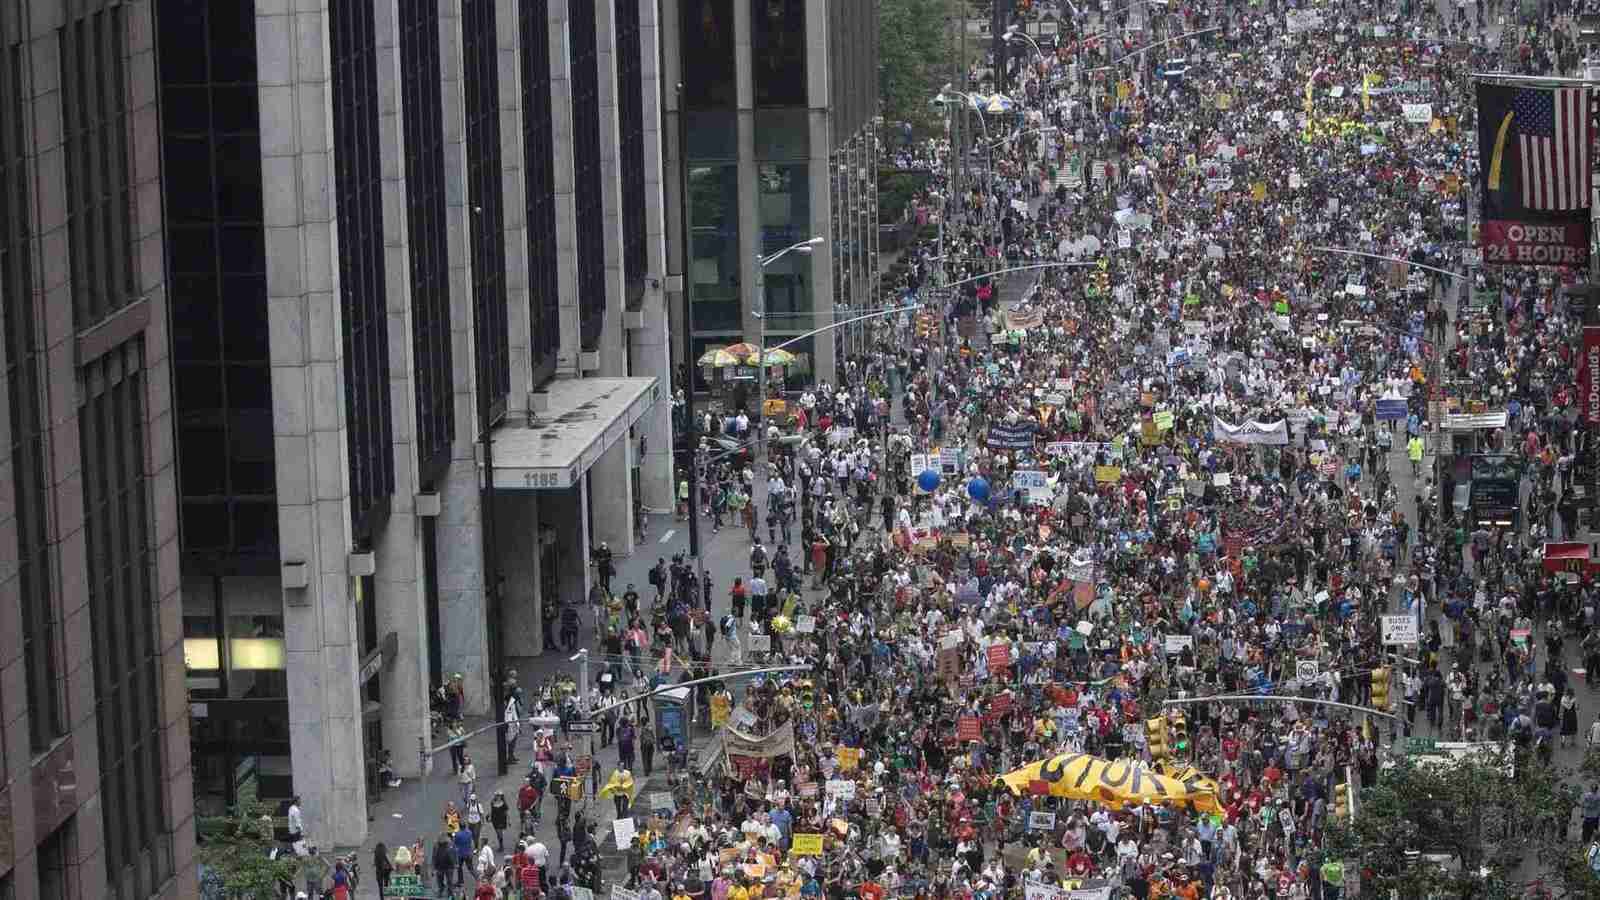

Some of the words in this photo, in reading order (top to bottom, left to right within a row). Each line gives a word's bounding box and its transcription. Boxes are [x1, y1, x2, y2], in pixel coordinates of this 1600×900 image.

[1508, 225, 1565, 242] OPEN
[1488, 243, 1510, 261] 24
[524, 472, 558, 486] 1185
